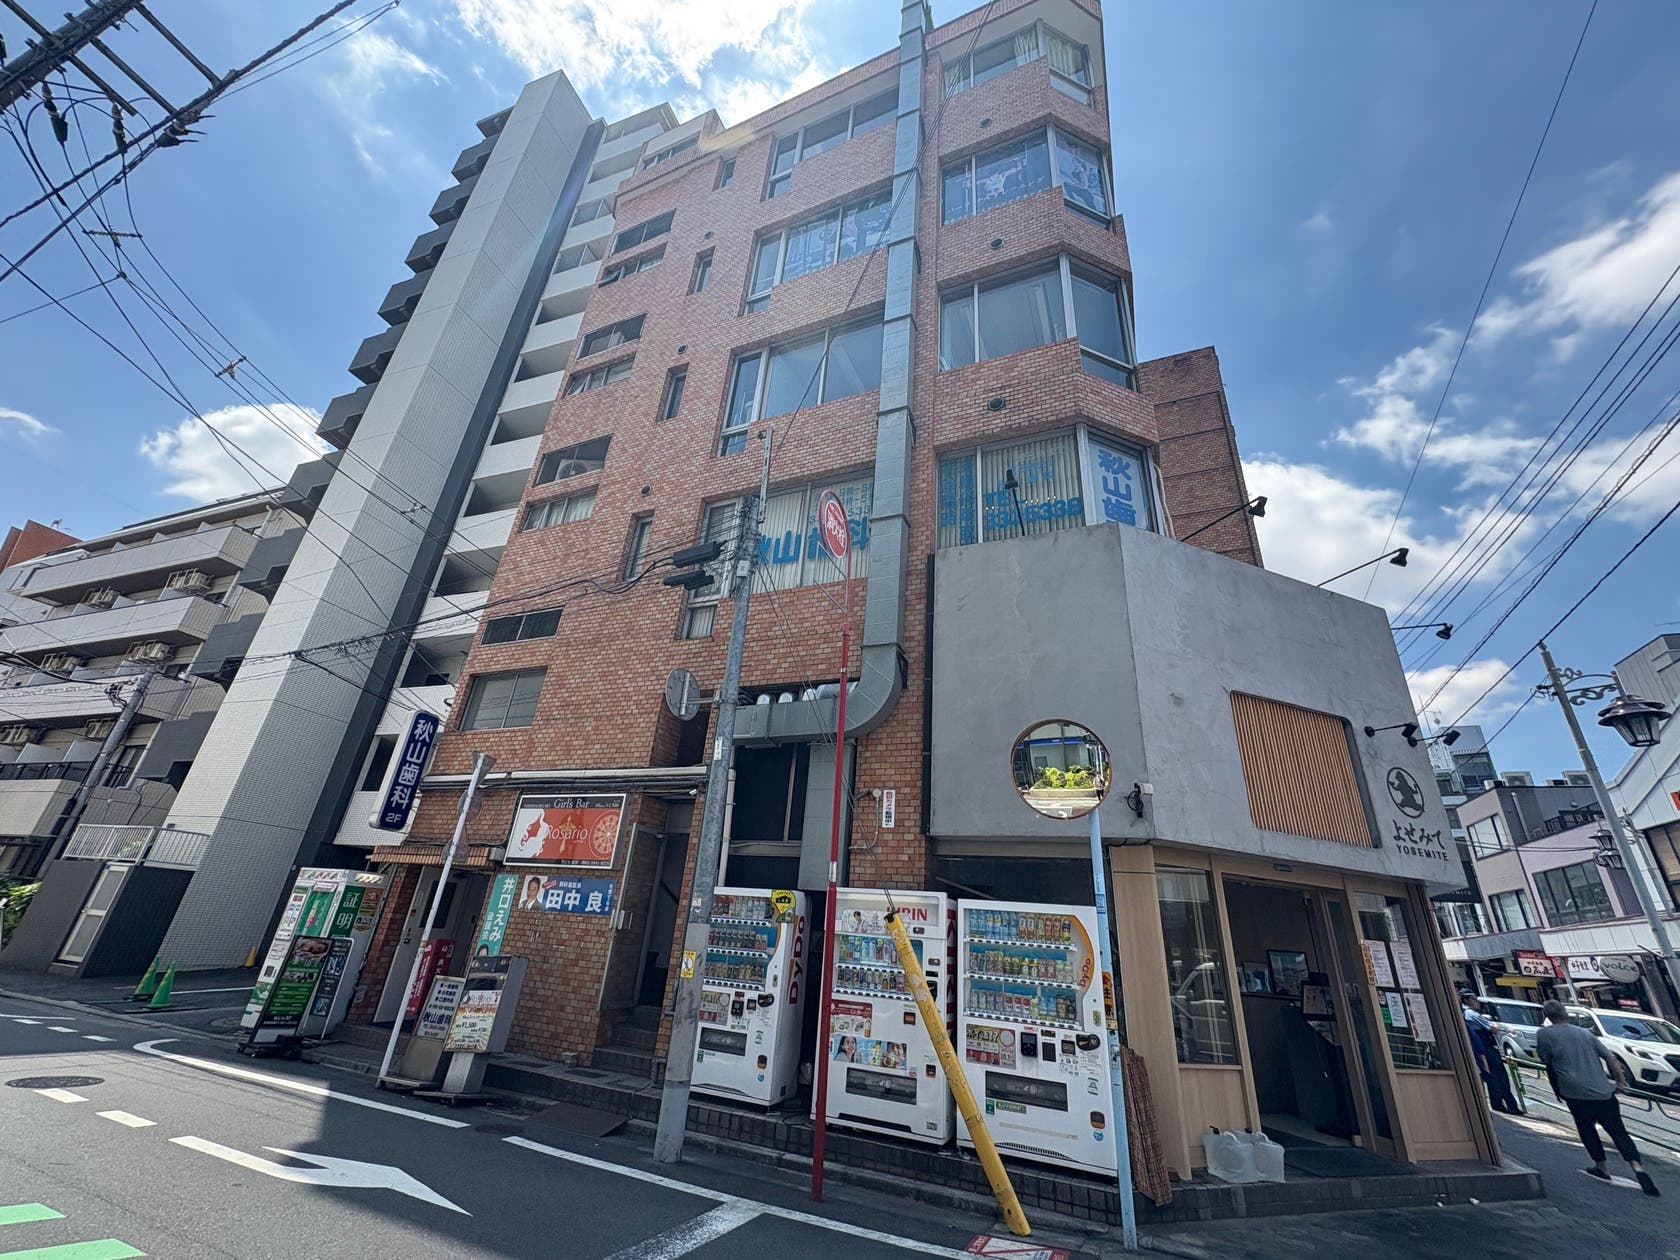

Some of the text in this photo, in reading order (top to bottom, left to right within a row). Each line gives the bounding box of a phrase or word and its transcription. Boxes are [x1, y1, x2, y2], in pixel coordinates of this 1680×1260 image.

[390, 719, 433, 810] 秋山歯科
[553, 798, 574, 809] Girl's
[576, 799, 590, 808] Bar
[385, 812, 402, 823] 2F
[547, 825, 589, 841] Rosario
[1392, 819, 1446, 850] よせみて
[1395, 843, 1449, 863] YOSEMITE
[488, 877, 514, 942] 井口えみ
[545, 889, 603, 913] 田中 良
[332, 891, 361, 937] 証明
[1603, 961, 1638, 973] voice
